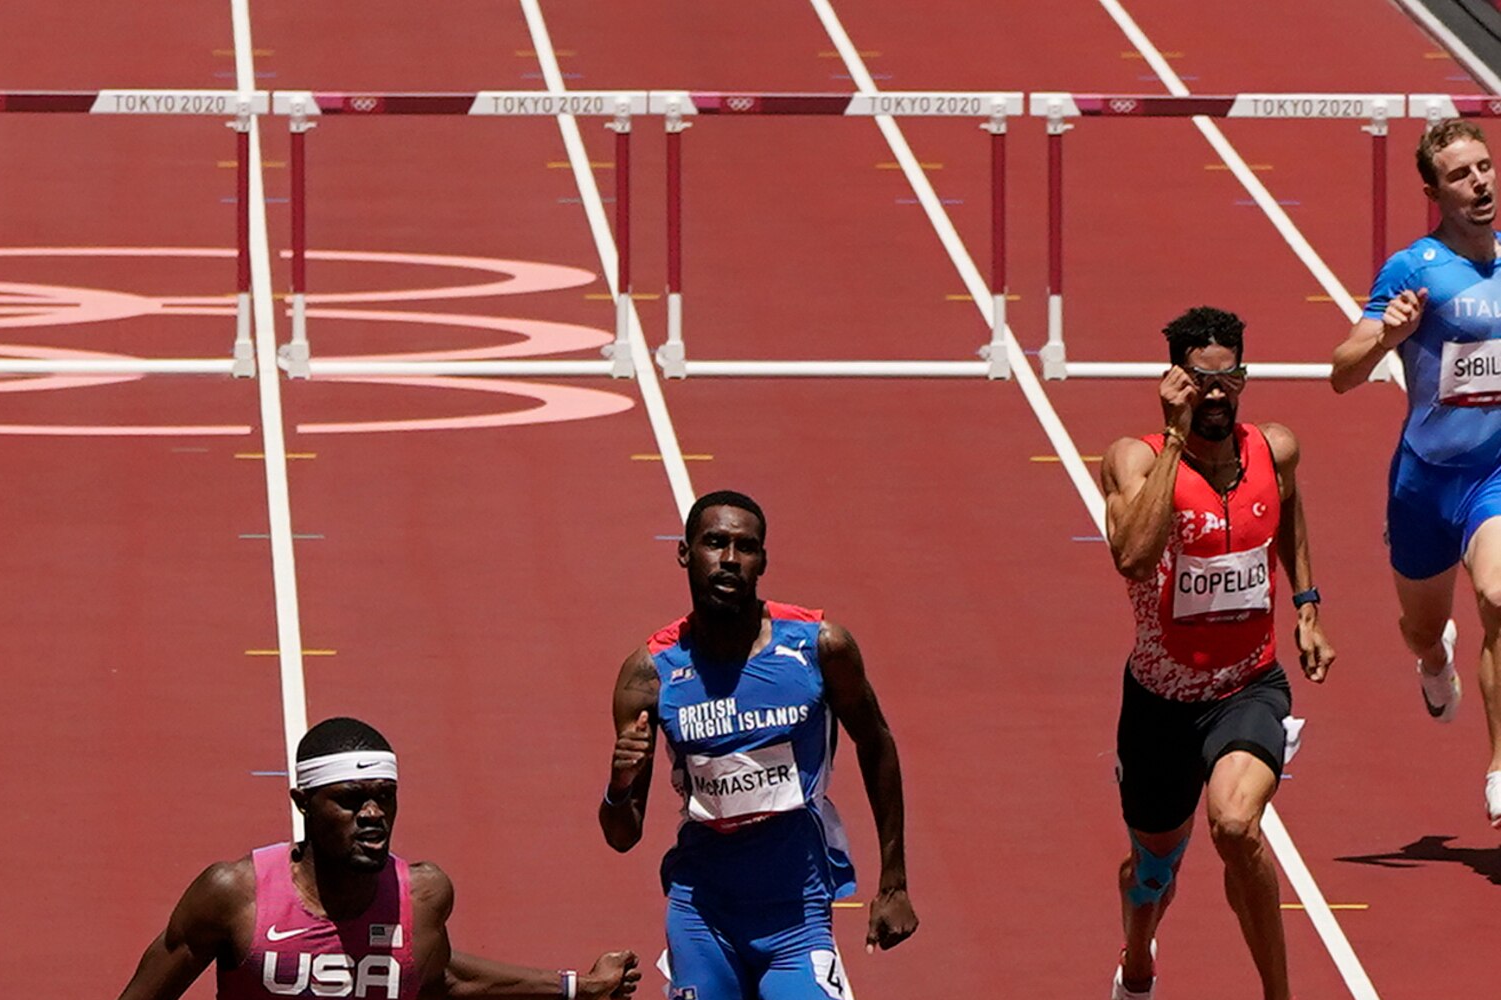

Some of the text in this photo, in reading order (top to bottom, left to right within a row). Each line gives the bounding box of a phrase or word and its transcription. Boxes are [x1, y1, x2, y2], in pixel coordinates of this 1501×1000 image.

[113, 94, 226, 113] TOKYO 2020
[491, 96, 604, 113] TOKYO 2020
[868, 96, 981, 114] TOKYO 2020
[1251, 99, 1364, 117] TOKYO 2020
[1454, 297, 1501, 318] ITAL
[1454, 356, 1501, 377] SIBIL
[1178, 562, 1267, 595] COPELLO
[678, 697, 737, 727] BRITISH
[681, 705, 810, 742] VIRGIN ISLANDS
[262, 950, 401, 1000] USA
